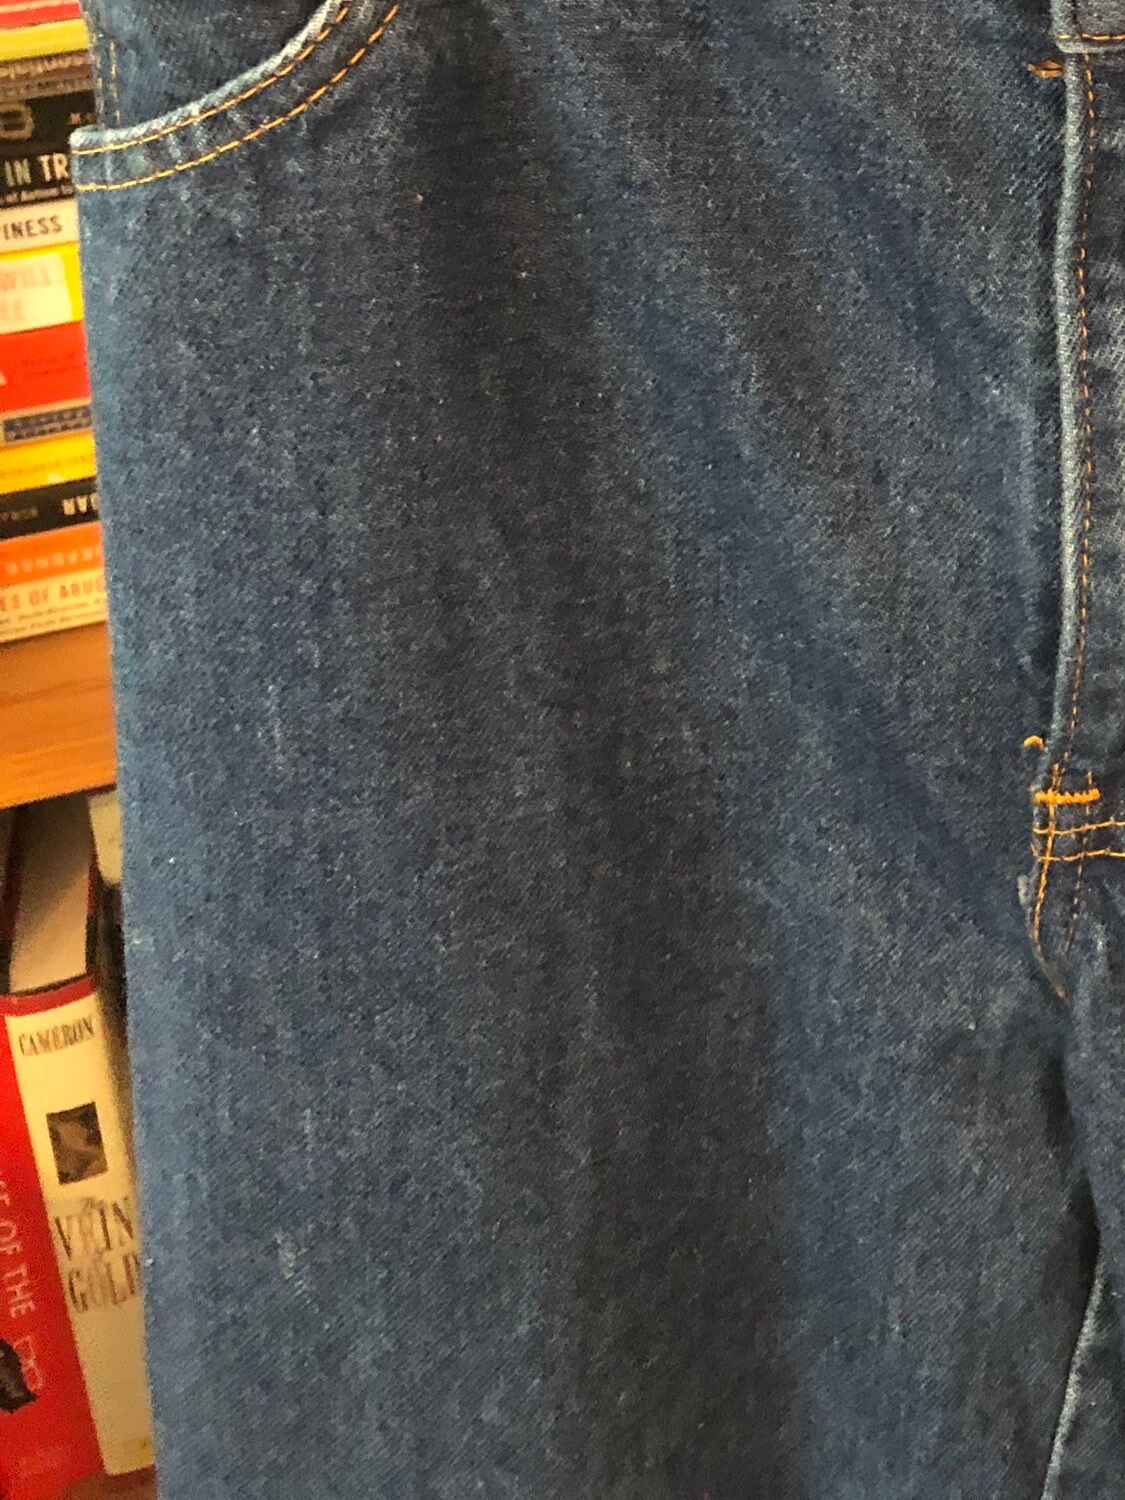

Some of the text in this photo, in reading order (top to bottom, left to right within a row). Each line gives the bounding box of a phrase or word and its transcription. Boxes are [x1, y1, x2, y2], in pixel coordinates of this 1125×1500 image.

[4, 157, 32, 188] IN
[18, 1014, 96, 1056] CAMERON
[3, 1261, 37, 1319] THE
